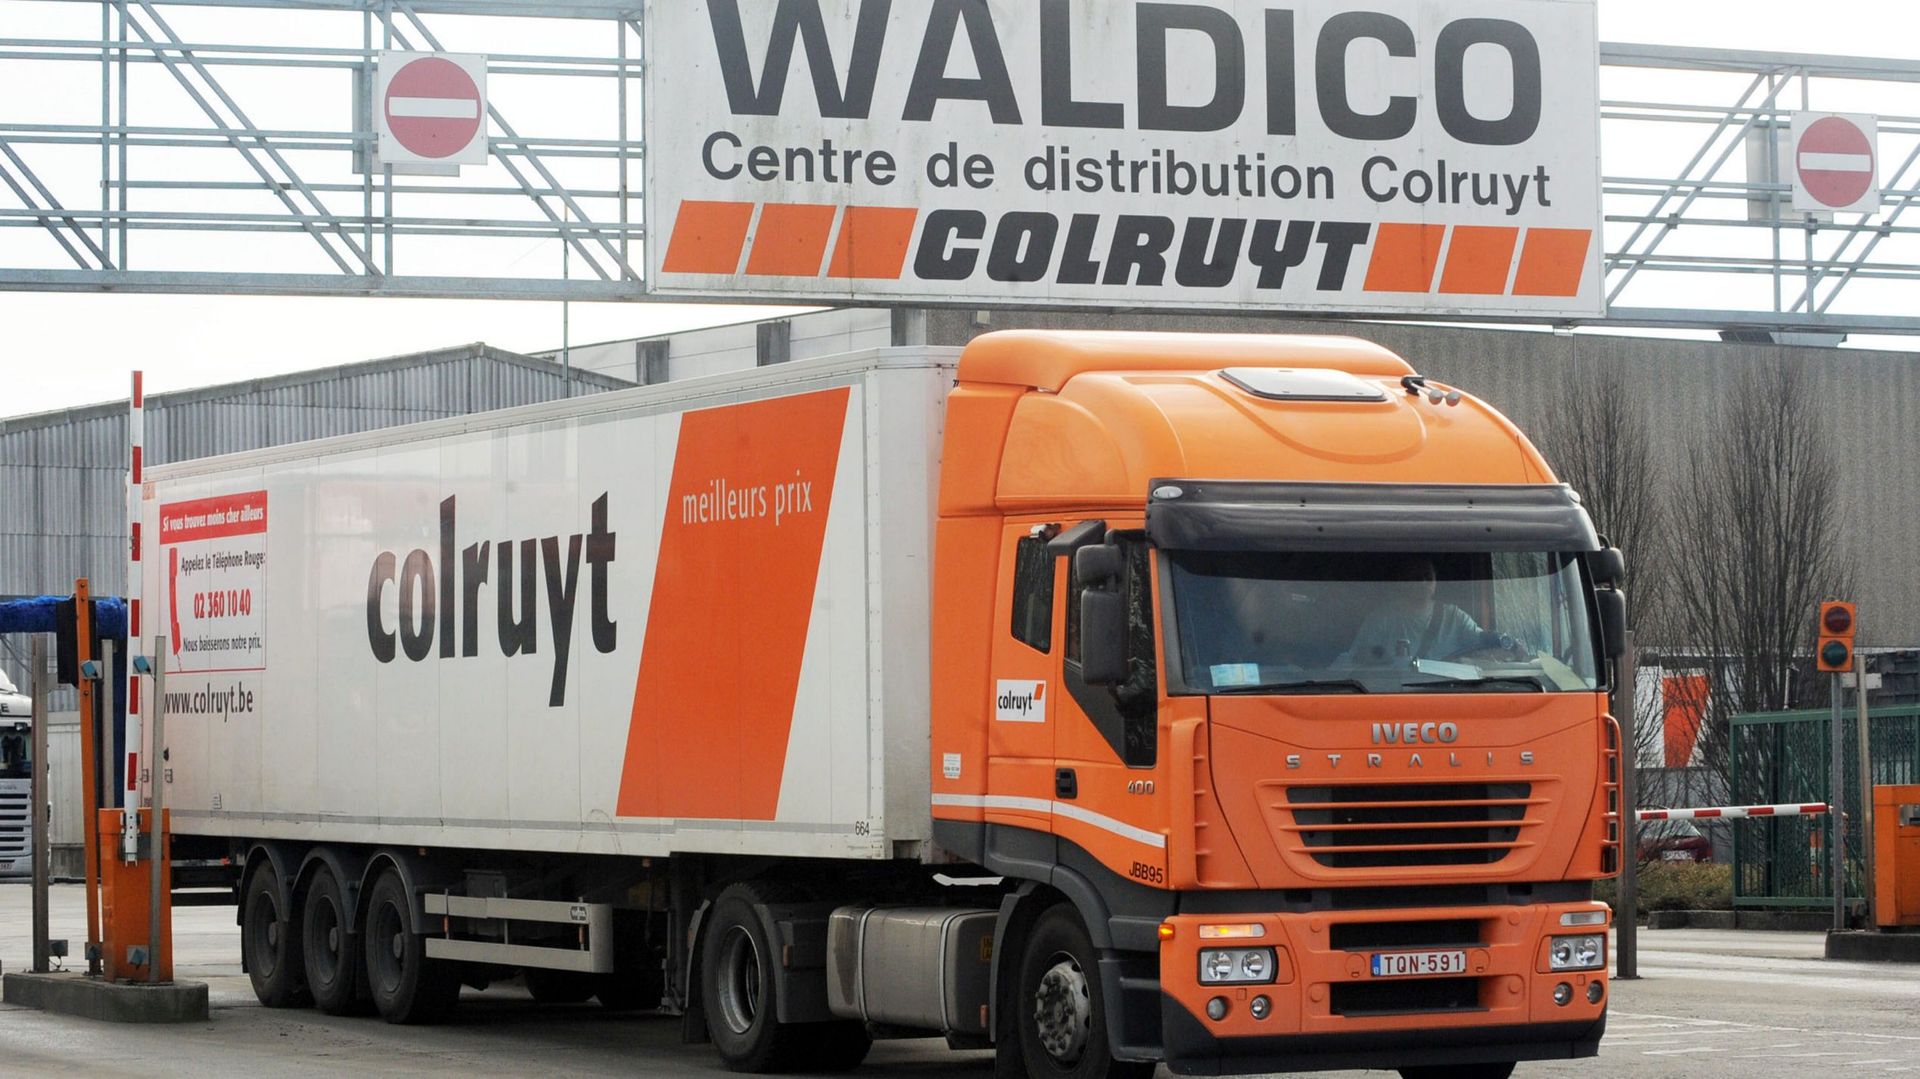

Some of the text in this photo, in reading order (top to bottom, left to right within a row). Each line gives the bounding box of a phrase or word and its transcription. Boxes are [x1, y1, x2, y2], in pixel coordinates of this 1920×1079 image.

[707, 0, 1542, 145] WALDICO
[702, 131, 1551, 216] Centre de distribution Colruyt
[913, 209, 1372, 292] COLRUYT
[682, 469, 812, 526] meilleurs prix
[162, 504, 264, 532] Si vous trouvez moins cher ailleurs
[181, 550, 266, 576] Appelez le Téléphone Rouge:
[194, 588, 251, 620] 02 360 10 40
[367, 491, 617, 708] colruyt
[183, 632, 262, 654] Nous baisserons notre prix.
[164, 681, 254, 723] www.colruyt.be
[998, 689, 1033, 717] colruyt
[1371, 722, 1458, 745] IVECO
[1286, 751, 1534, 770] STRALIS
[1127, 780, 1155, 795] 400
[855, 820, 870, 836] 664
[1128, 861, 1164, 884] JBB95
[1384, 953, 1461, 974] TQN-591
